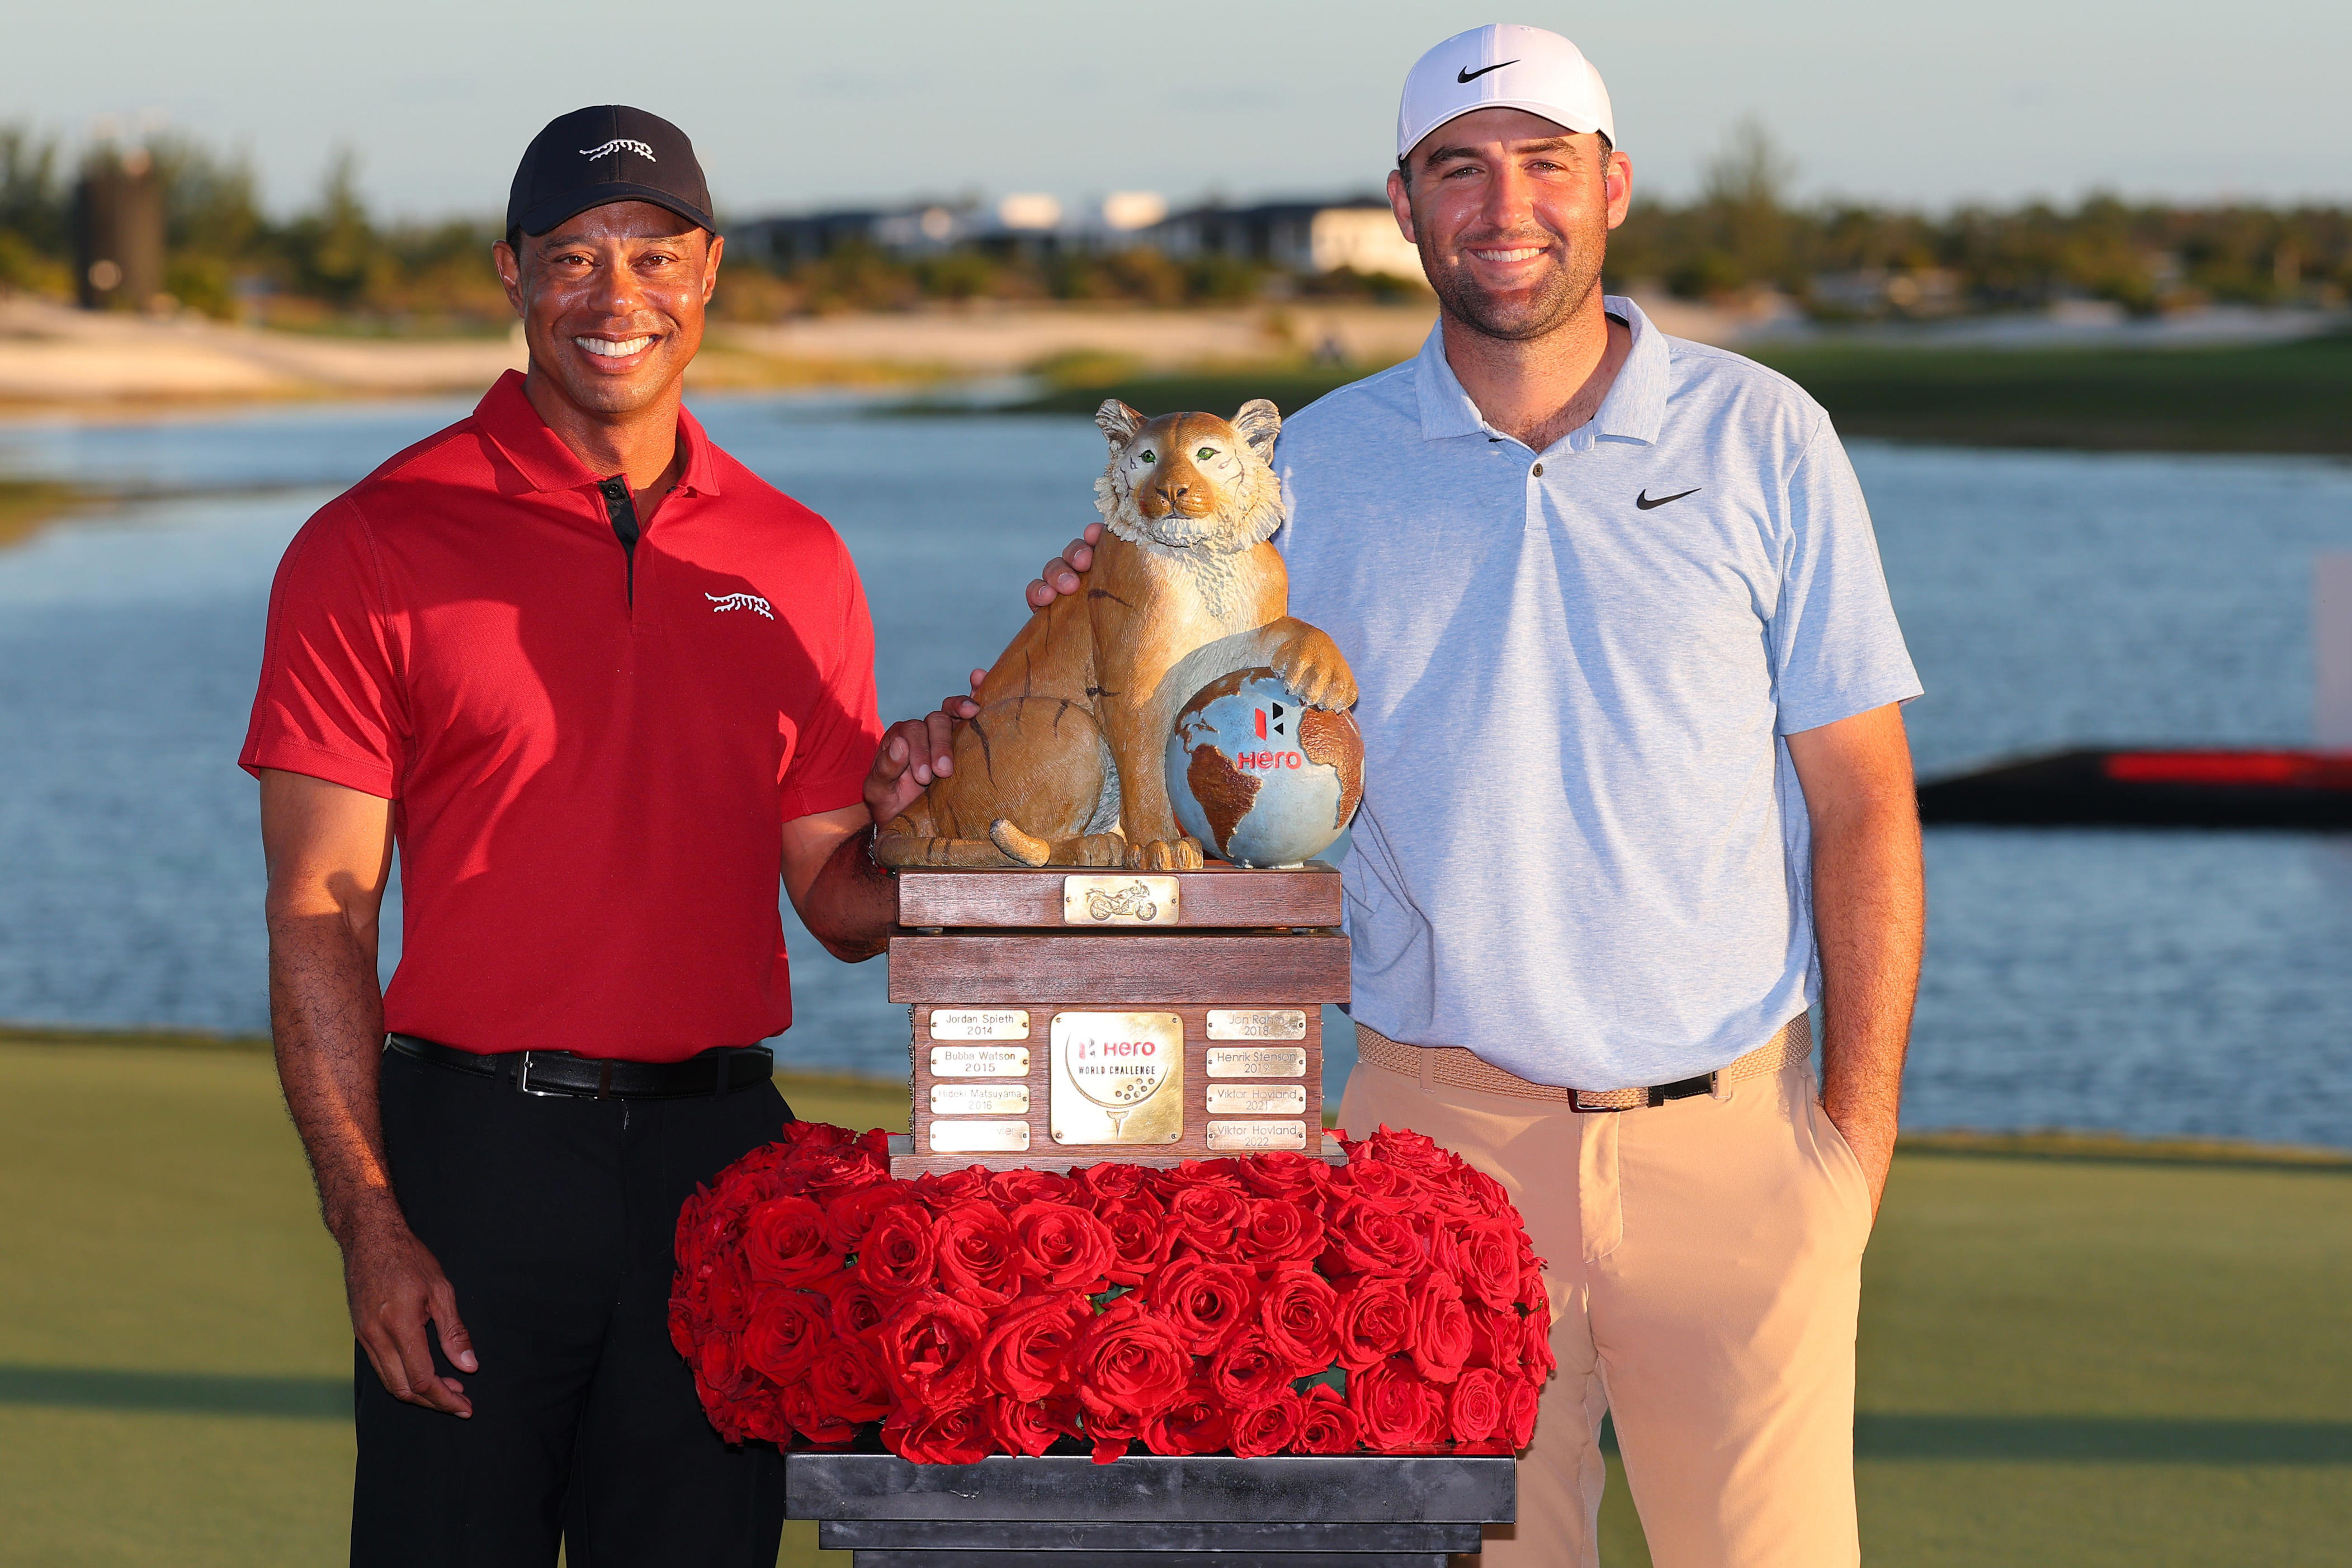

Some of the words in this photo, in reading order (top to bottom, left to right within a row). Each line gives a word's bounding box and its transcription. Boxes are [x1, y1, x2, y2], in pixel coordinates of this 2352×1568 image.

[1238, 750, 1302, 771] Hero
[946, 1014, 977, 1023] Jordan
[982, 1014, 1014, 1025] Spieth
[1229, 1014, 1249, 1024] Jon
[1252, 1014, 1284, 1024] Rahm
[967, 1027, 993, 1035] 2014
[1244, 1026, 1269, 1036] 2018
[1104, 1041, 1156, 1057] Hero
[945, 1051, 975, 1060] Bubba
[979, 1051, 1016, 1060] Watson
[1217, 1052, 1250, 1062] Henrik
[1253, 1052, 1296, 1062] Stenson
[965, 1063, 996, 1072] 2015
[1078, 1066, 1106, 1075] WORLD
[1109, 1066, 1156, 1075] CHALLENGE
[1244, 1064, 1269, 1073] 2019
[971, 1089, 1022, 1099] Matsuyama
[1217, 1089, 1247, 1098] Viktor
[1253, 1089, 1297, 1098] Hovland
[968, 1101, 993, 1110] 2016
[1246, 1101, 1268, 1111] 2021
[1217, 1125, 1247, 1135] Viktor
[1253, 1125, 1297, 1135] Hovland
[1245, 1137, 1269, 1146] 2022
